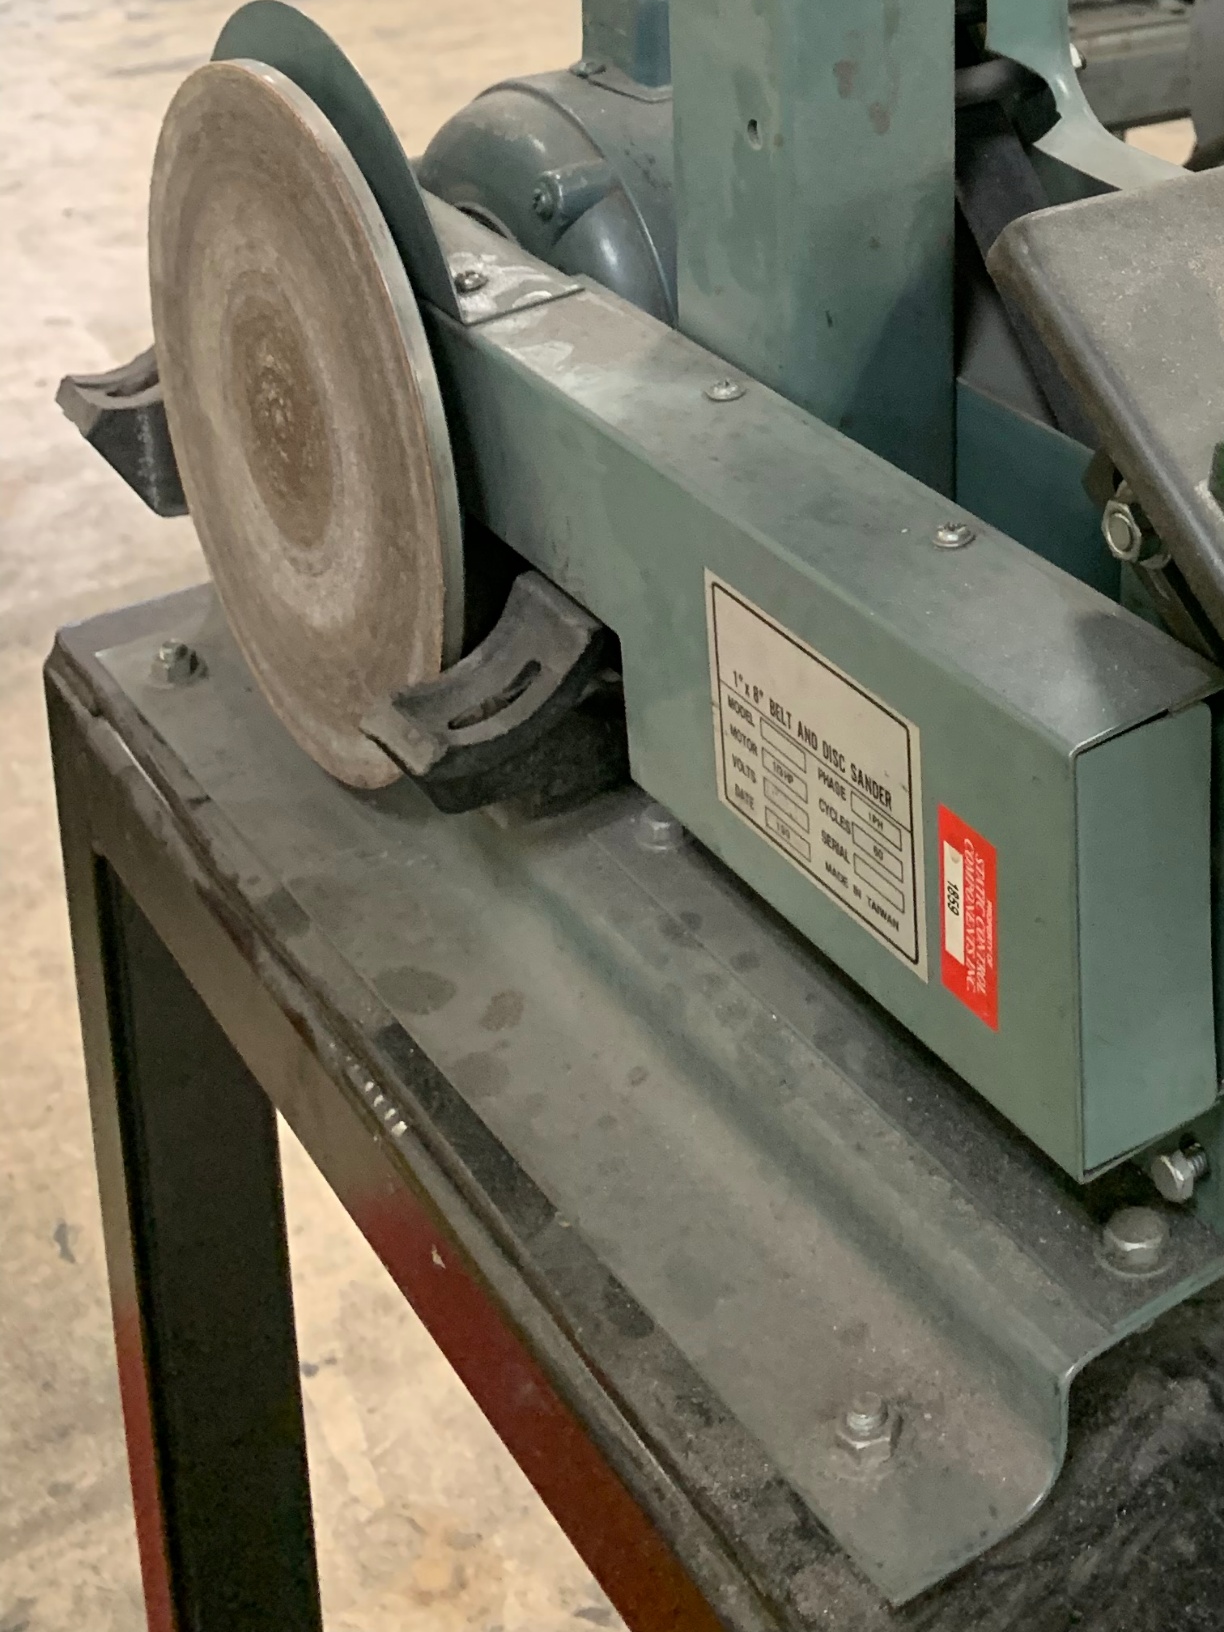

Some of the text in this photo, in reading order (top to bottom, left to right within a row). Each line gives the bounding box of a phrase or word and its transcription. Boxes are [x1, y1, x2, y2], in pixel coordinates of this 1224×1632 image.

[727, 695, 755, 727] MODEL
[730, 724, 758, 757] MOTOR
[769, 698, 792, 729] BELT
[798, 721, 818, 750] AND
[823, 740, 845, 773] DISC
[850, 763, 892, 811] SANDER
[732, 753, 757, 784] VOLTS
[818, 767, 847, 802] PHASE
[735, 783, 755, 810] DATE
[819, 798, 851, 835] CYCLES
[821, 829, 850, 864] SERIAL
[825, 861, 900, 932] MADE IN TAIWAN
[948, 880, 959, 916] 1859
[965, 837, 976, 958] COMPONENTS
[976, 853, 986, 995] STATIC CONTROL
